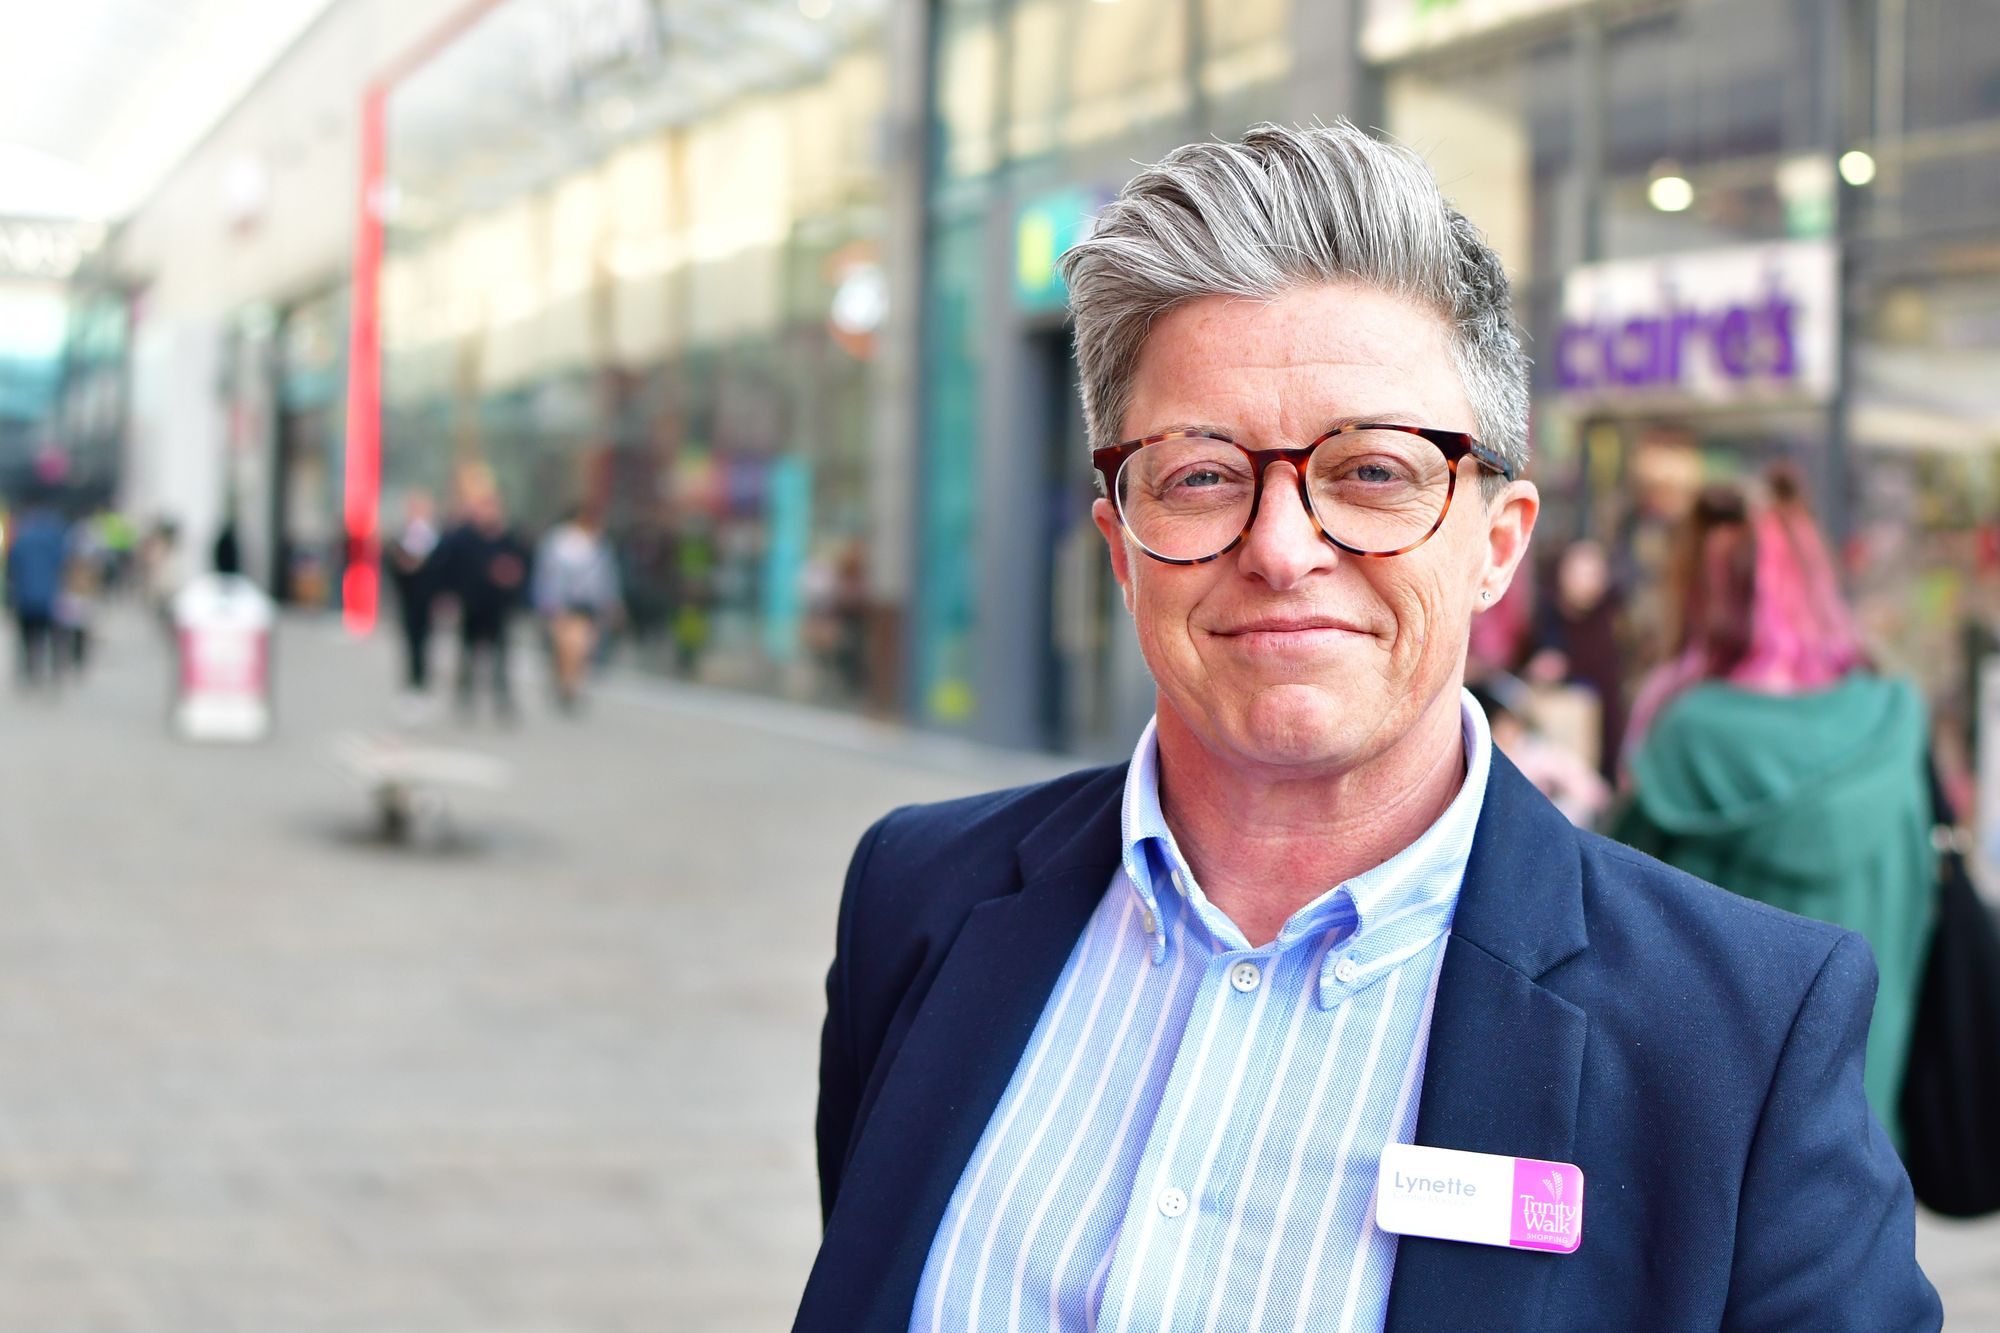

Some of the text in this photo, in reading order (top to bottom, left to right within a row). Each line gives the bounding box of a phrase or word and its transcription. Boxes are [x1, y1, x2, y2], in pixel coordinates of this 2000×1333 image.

[1394, 1171, 1477, 1197] Lynette
[1520, 1194, 1576, 1221] Trinity
[1523, 1212, 1570, 1234] Walk
[1527, 1233, 1569, 1244] SHOPPING
